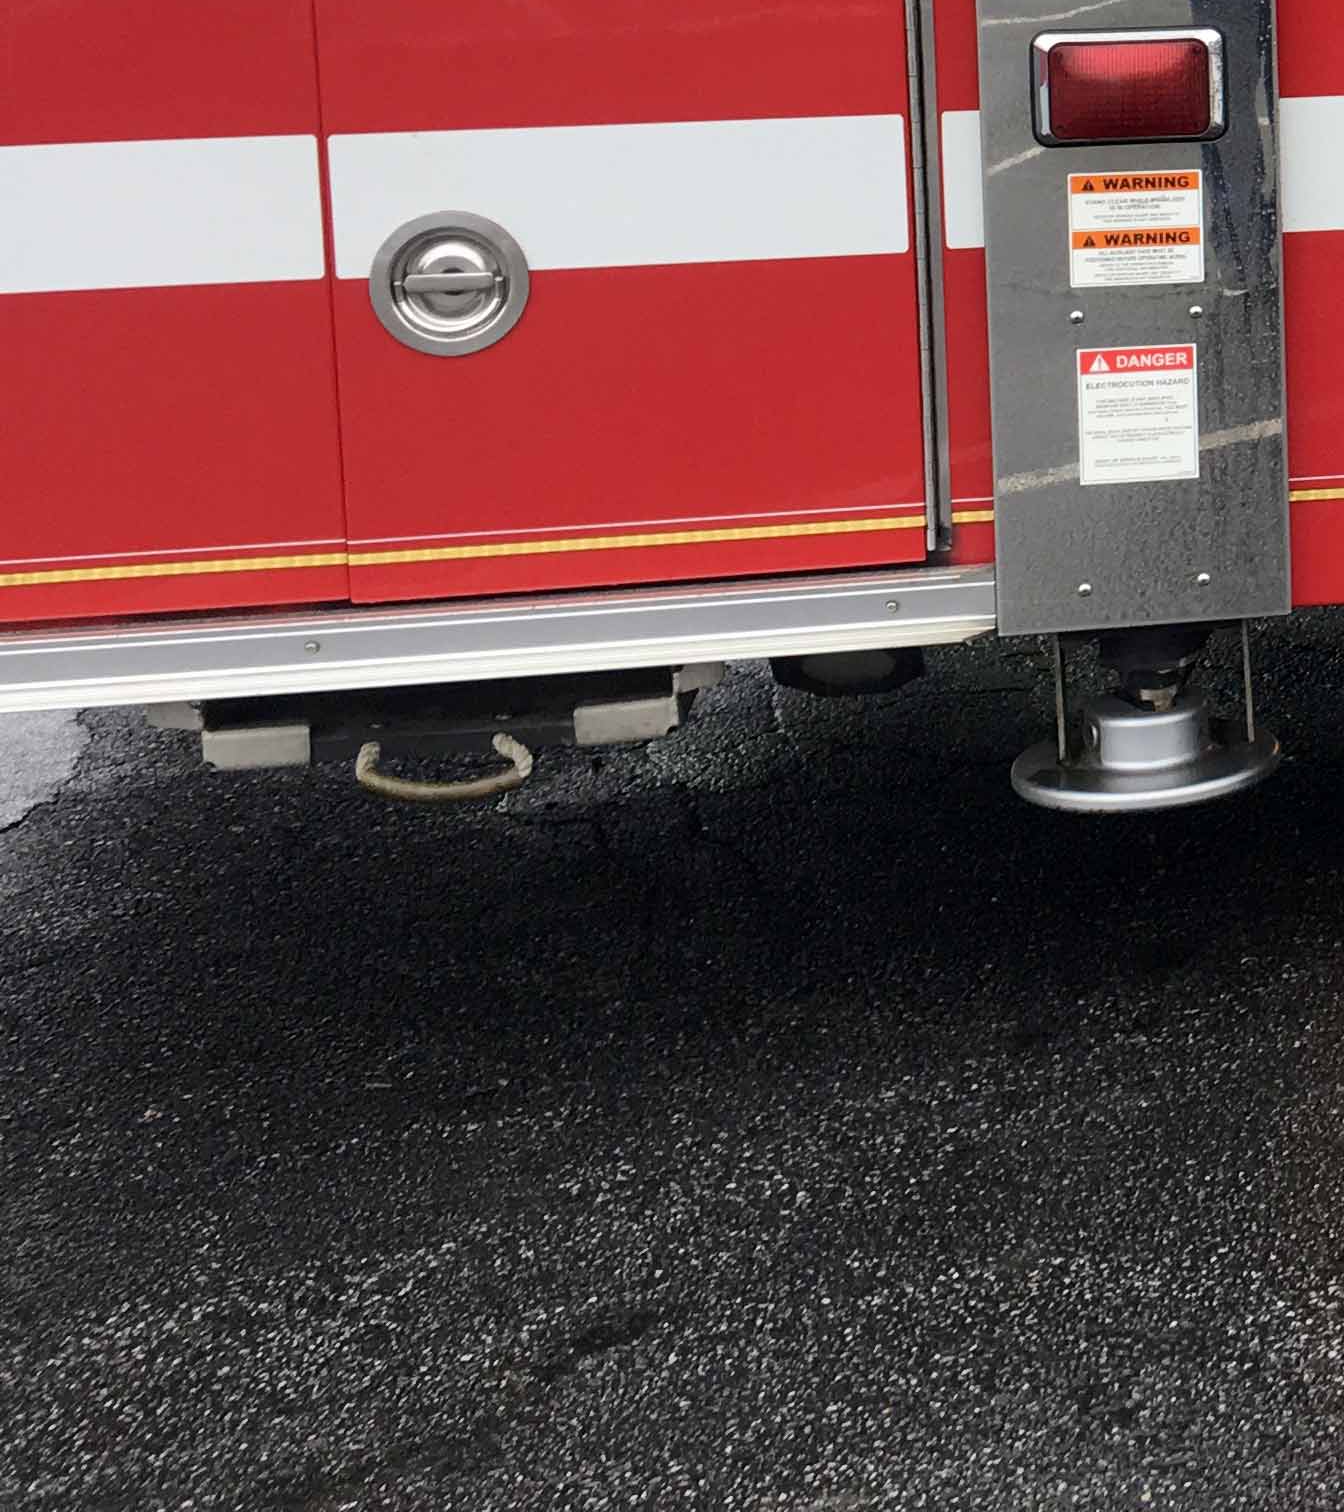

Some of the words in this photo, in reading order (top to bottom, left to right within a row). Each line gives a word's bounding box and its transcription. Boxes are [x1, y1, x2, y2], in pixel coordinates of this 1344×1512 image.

[1103, 176, 1190, 190] WARNING
[1104, 231, 1190, 246] WARNING
[1116, 352, 1188, 368] DANGER
